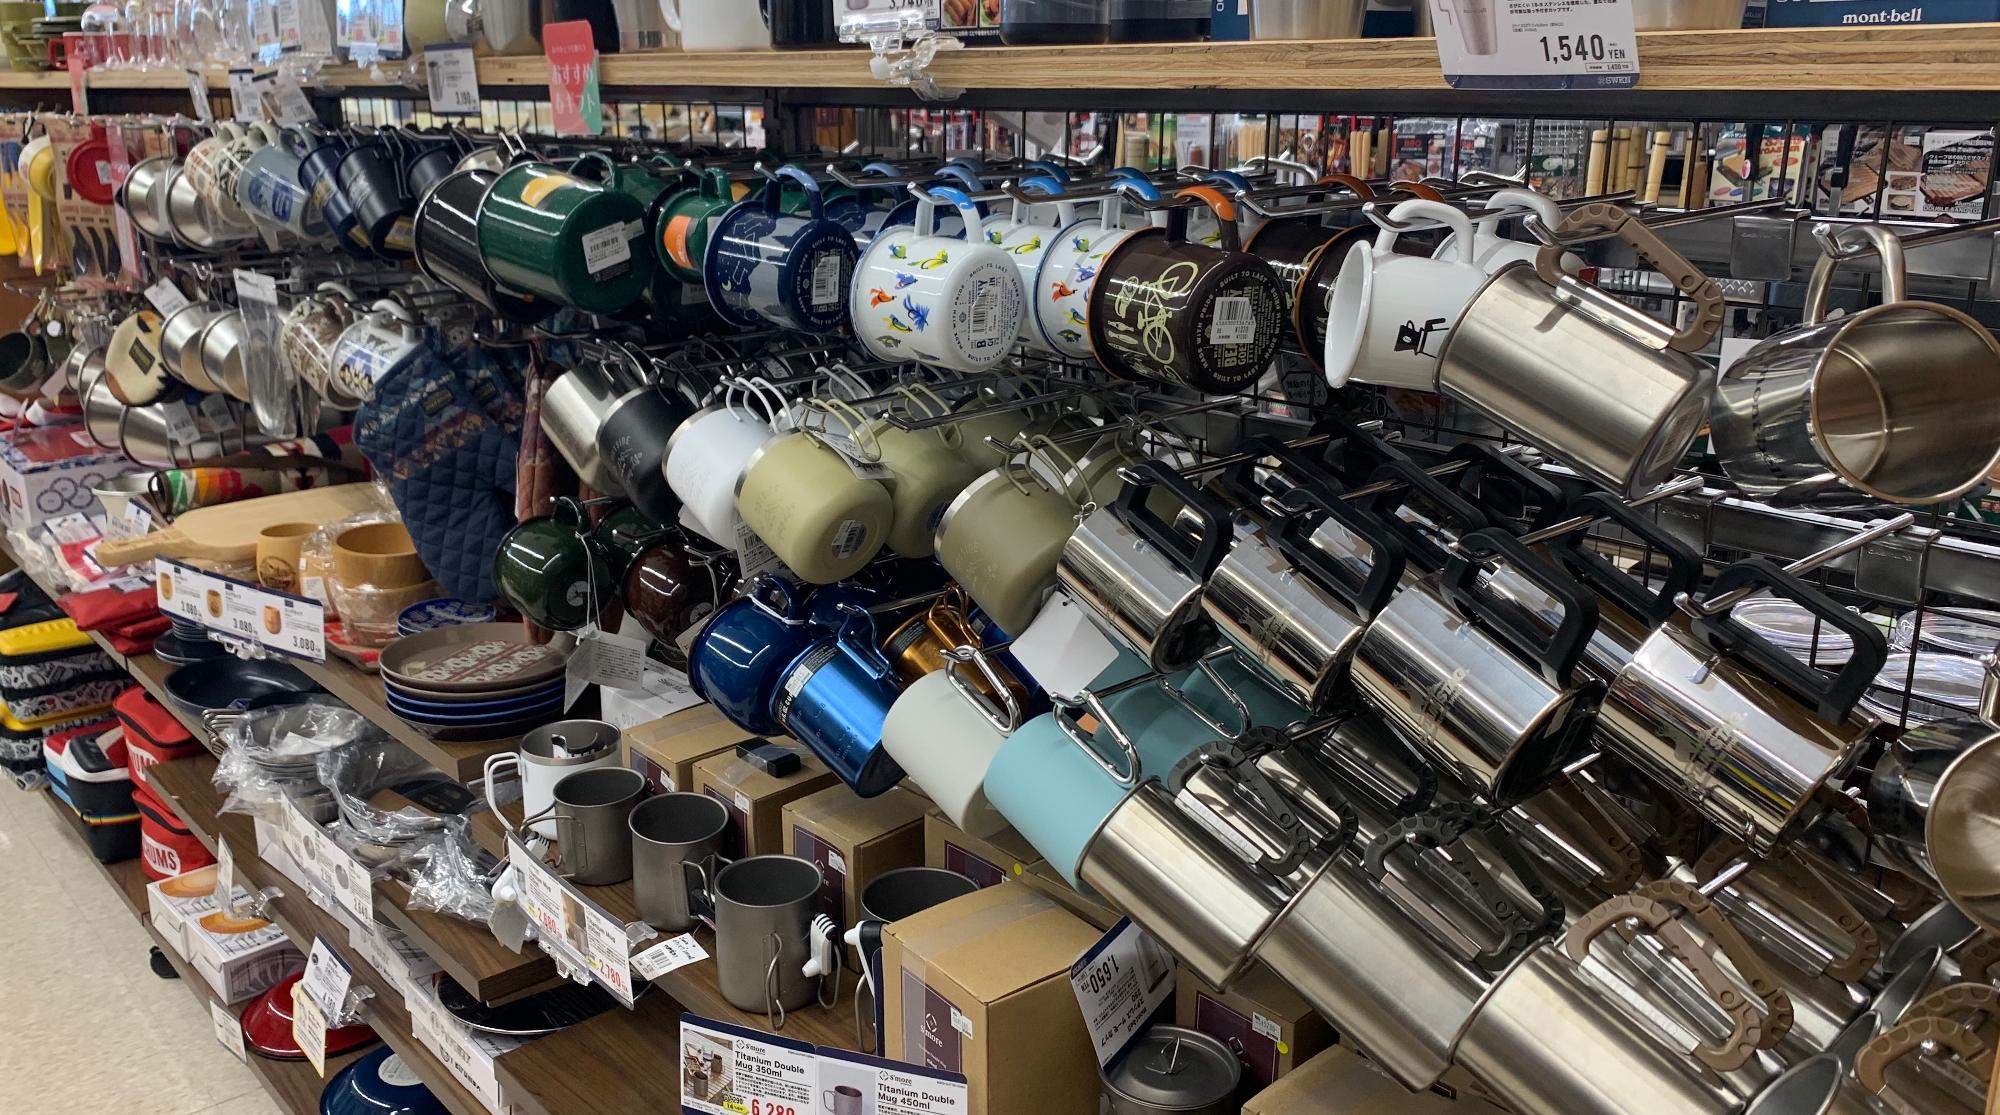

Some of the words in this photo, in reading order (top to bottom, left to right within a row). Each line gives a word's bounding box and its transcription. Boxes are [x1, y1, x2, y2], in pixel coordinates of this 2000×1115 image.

[1539, 34, 1605, 64] 1,540
[1608, 49, 1626, 59] YEN
[1219, 272, 1239, 288] BUILT
[1252, 271, 1268, 283] LAST
[1212, 371, 1231, 382] BUILT
[1243, 365, 1259, 378] LAST
[1089, 954, 1119, 993] 1,650
[734, 1050, 772, 1067] Titanium
[774, 1060, 805, 1074] Double
[735, 1060, 753, 1071] Mug
[755, 1064, 782, 1078] 350ml
[878, 1082, 919, 1098] Titanium
[921, 1092, 955, 1105] Double
[878, 1092, 898, 1103] Mug
[900, 1097, 930, 1110] 450ml
